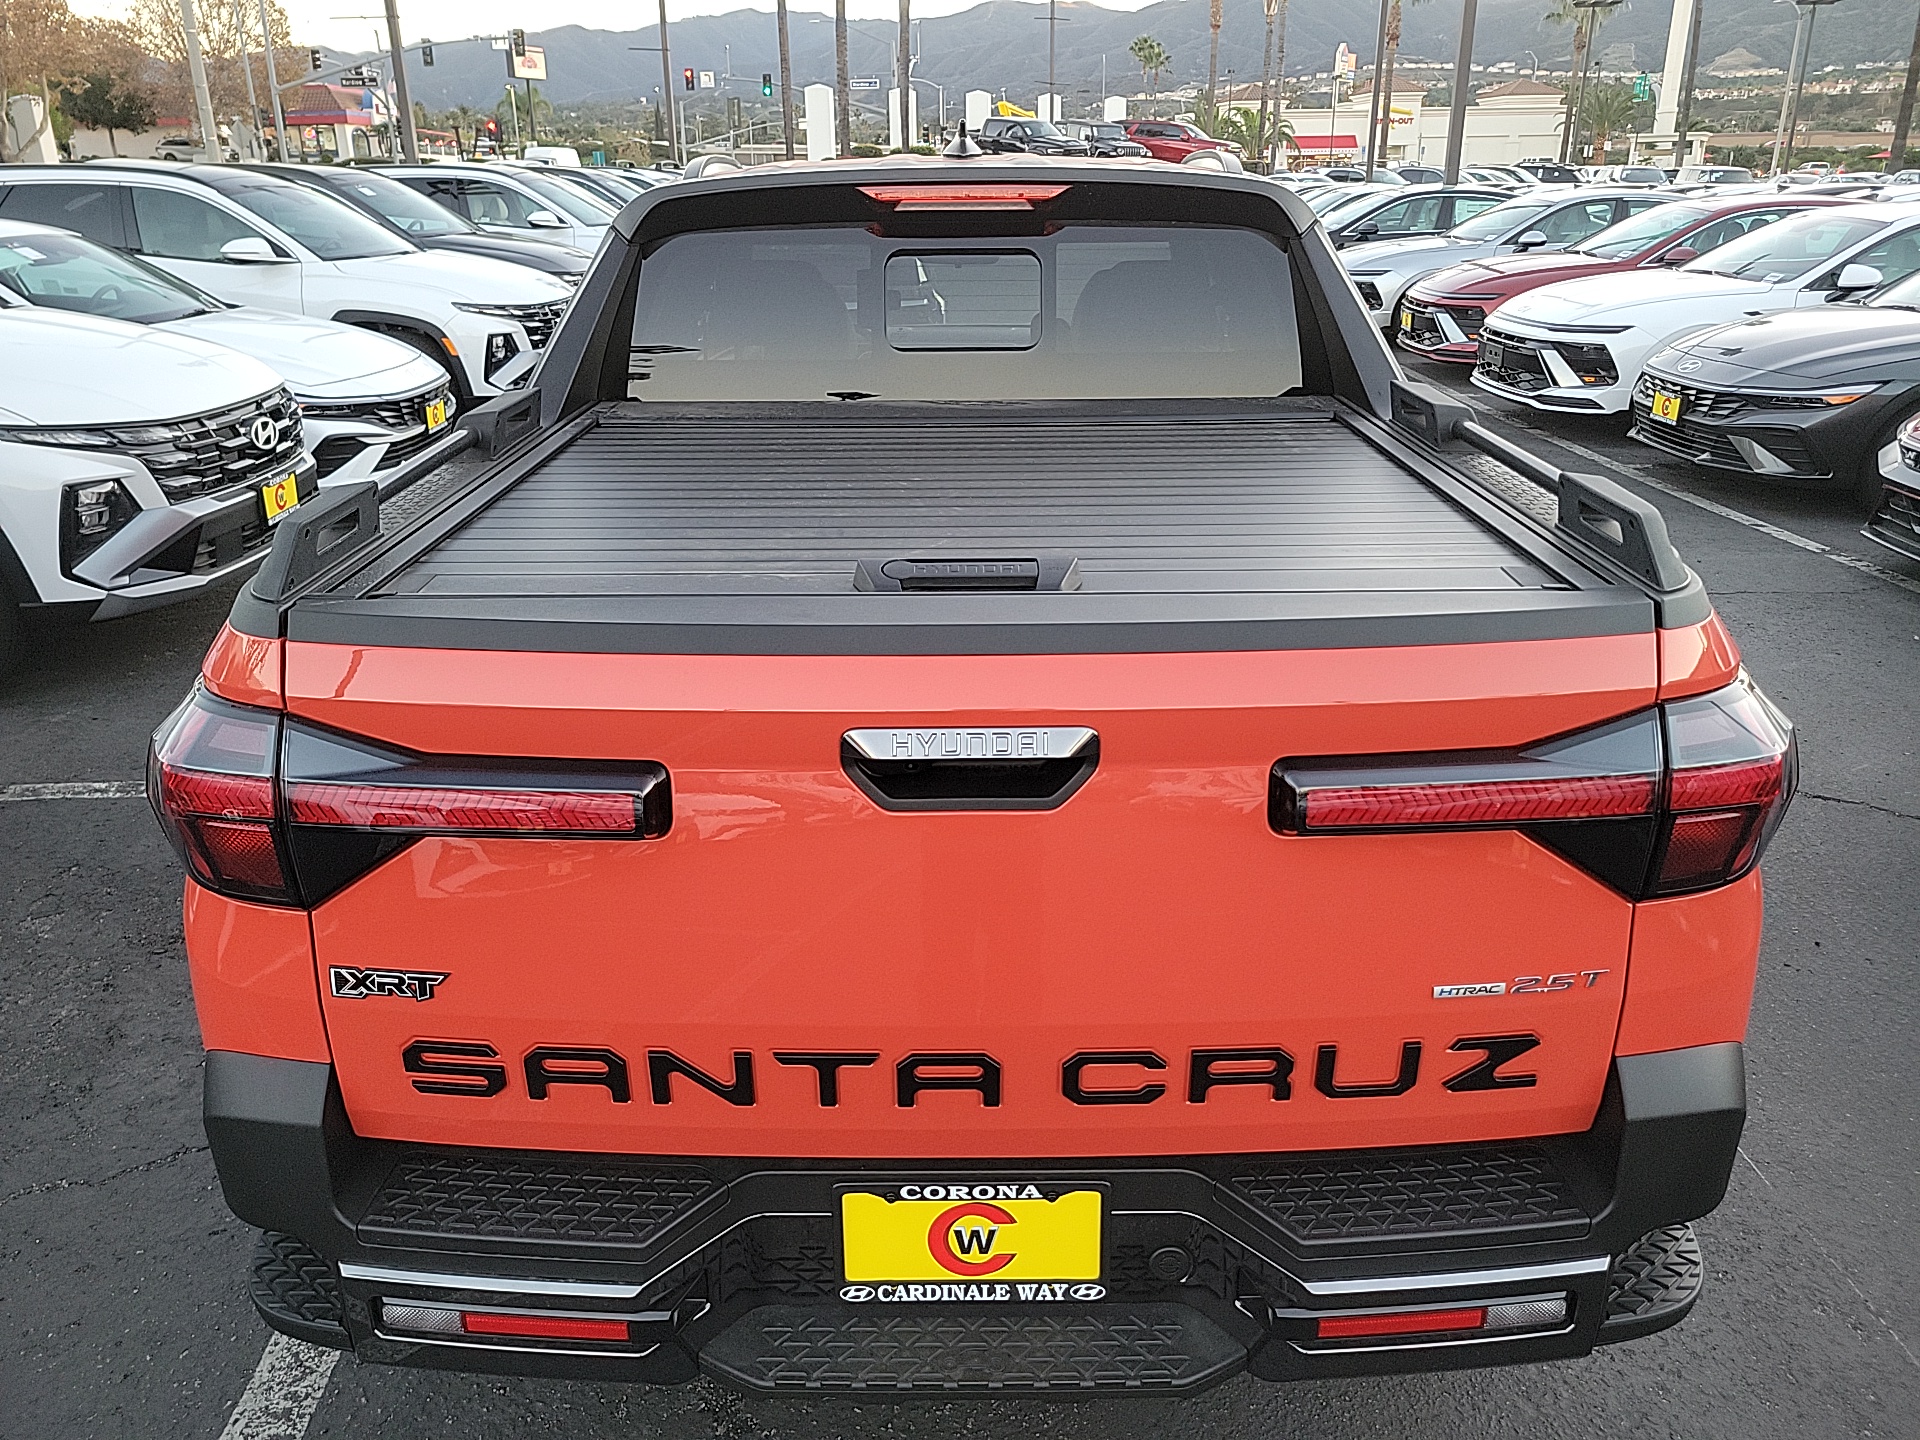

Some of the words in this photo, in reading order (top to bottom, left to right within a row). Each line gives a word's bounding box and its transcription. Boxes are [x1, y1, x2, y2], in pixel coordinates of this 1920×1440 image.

[912, 564, 1024, 574] HYUNDAI
[891, 732, 1049, 757] HYUNDAI
[329, 966, 452, 1001] XRT
[1438, 984, 1502, 997] HTRAC
[402, 1038, 1002, 1108] SANTA
[1061, 1034, 1542, 1106] CRUZ
[900, 1185, 1043, 1200] CORONA
[877, 1283, 1011, 1302] CARDINALE
[1015, 1283, 1070, 1302] WAY
